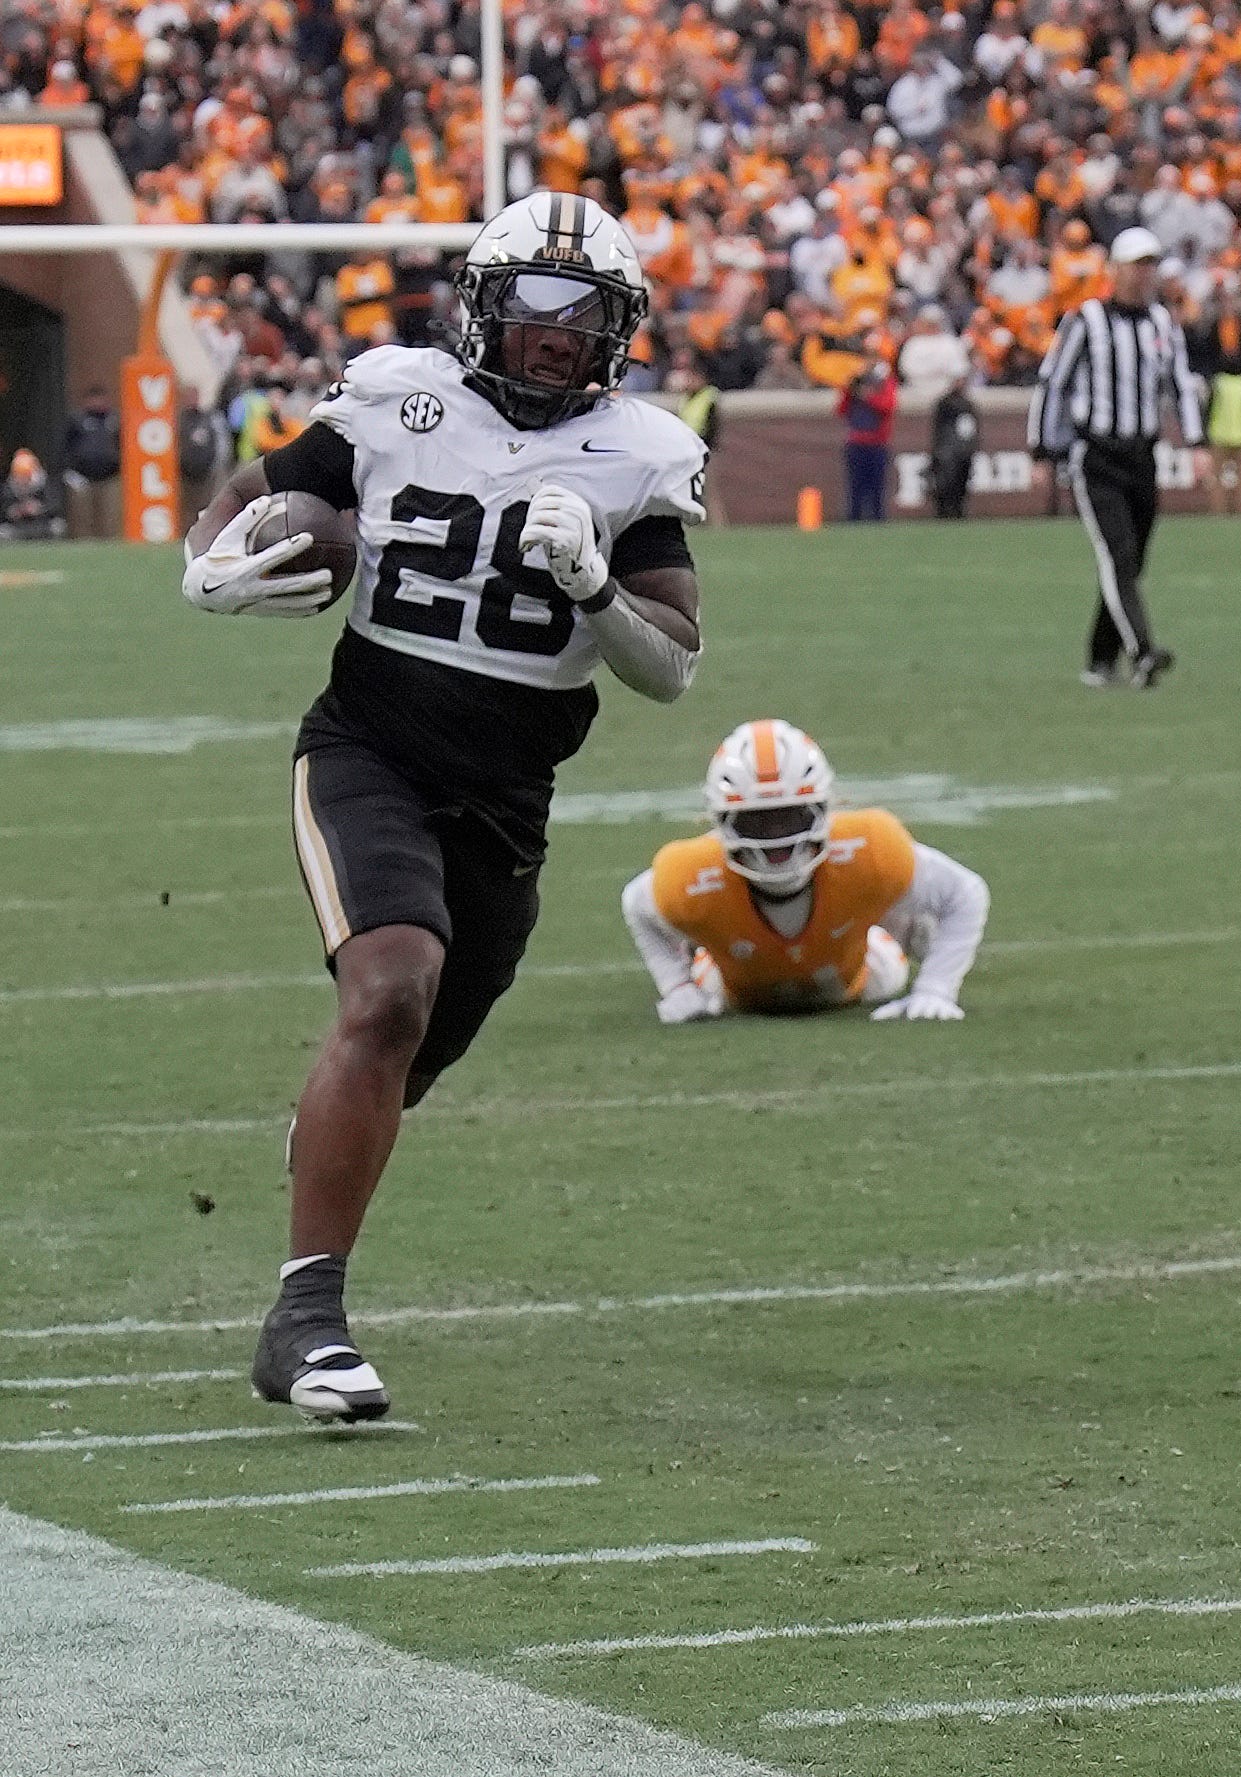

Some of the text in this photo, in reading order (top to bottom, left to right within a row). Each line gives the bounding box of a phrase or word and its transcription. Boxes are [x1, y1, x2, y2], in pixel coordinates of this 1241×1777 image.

[137, 374, 173, 542] VOLS
[401, 391, 444, 433] SEC
[370, 484, 600, 656] 28
